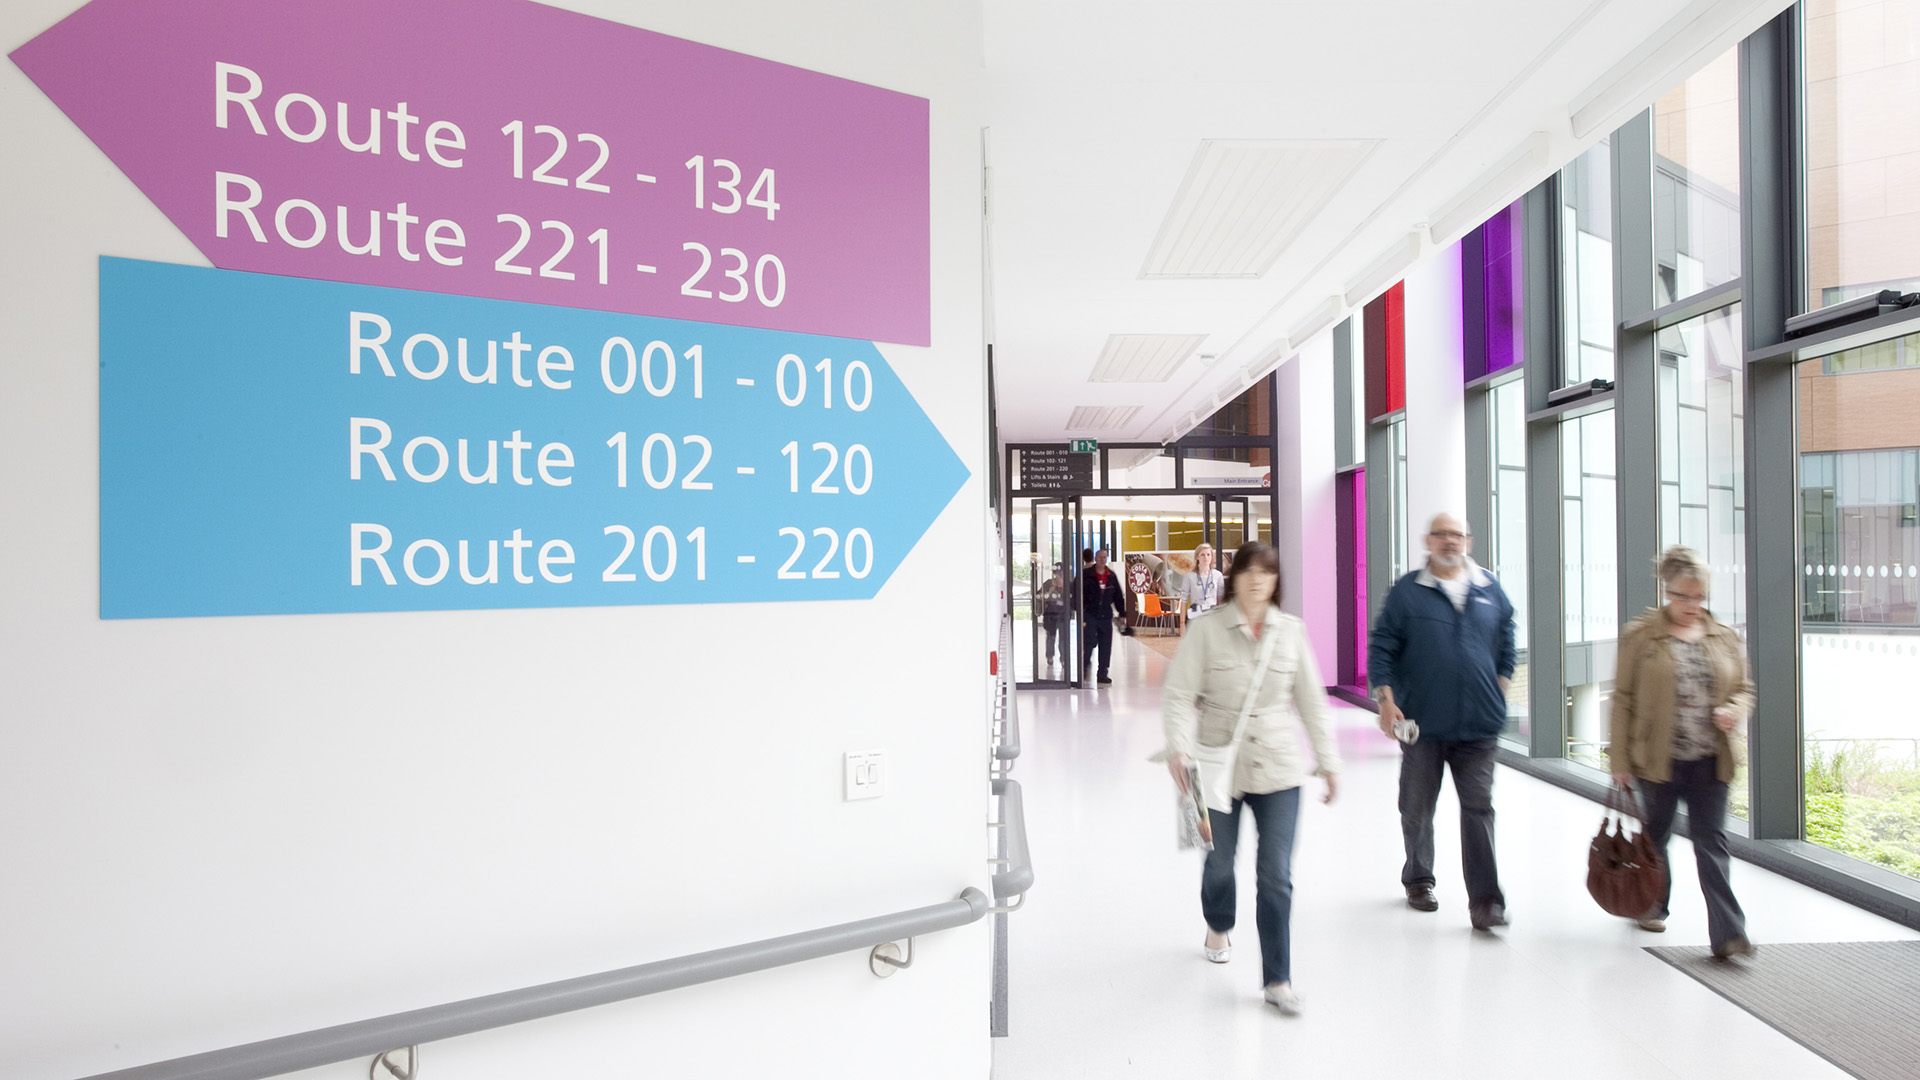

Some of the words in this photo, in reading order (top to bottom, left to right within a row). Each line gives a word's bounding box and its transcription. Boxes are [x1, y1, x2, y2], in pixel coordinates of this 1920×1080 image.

[215, 62, 466, 169] Route
[501, 119, 611, 194] 122
[636, 173, 657, 184] -
[685, 154, 781, 221] 134
[215, 171, 466, 267] Route
[494, 213, 608, 285] 221
[636, 264, 657, 274] -
[680, 241, 786, 308] 230
[349, 311, 575, 390] Route
[600, 336, 703, 399] 001
[736, 377, 755, 387] -
[775, 353, 873, 412] 010
[350, 417, 575, 490] Route
[606, 431, 714, 493] 102
[736, 466, 756, 475] -
[780, 440, 873, 496] 120
[350, 522, 576, 586] Route
[602, 524, 706, 583] 201
[737, 555, 756, 563] -
[777, 526, 874, 580] 220
[1130, 582, 1149, 592] COFFEE
[1131, 565, 1147, 574] COSTA
